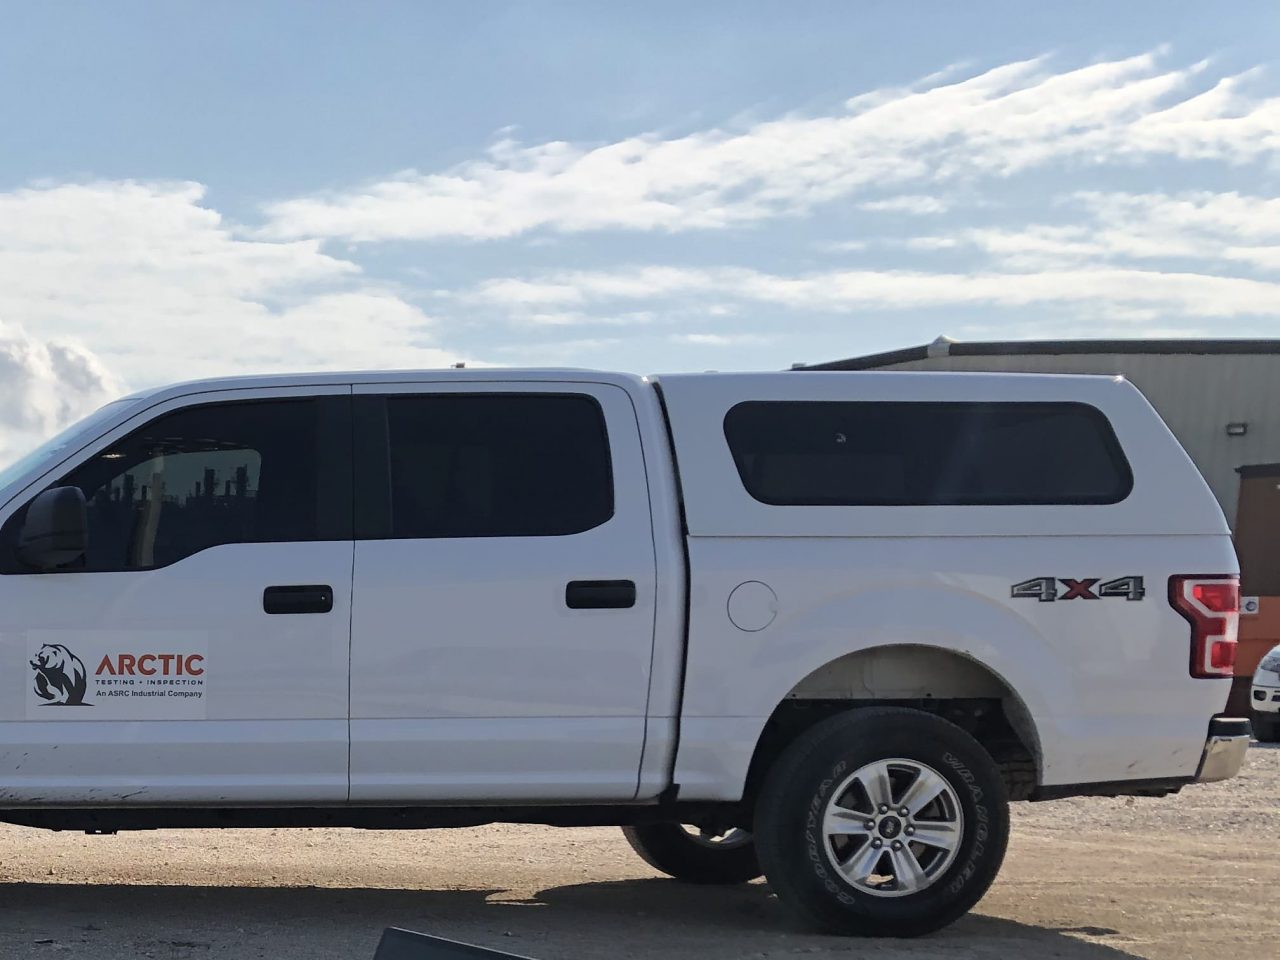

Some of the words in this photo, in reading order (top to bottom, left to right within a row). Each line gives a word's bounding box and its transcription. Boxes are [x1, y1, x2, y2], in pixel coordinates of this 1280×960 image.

[95, 654, 204, 675] ARCTIC
[96, 689, 107, 697] An
[108, 689, 130, 697] ASRC
[131, 689, 166, 697] Industrial
[167, 690, 202, 698] Company
